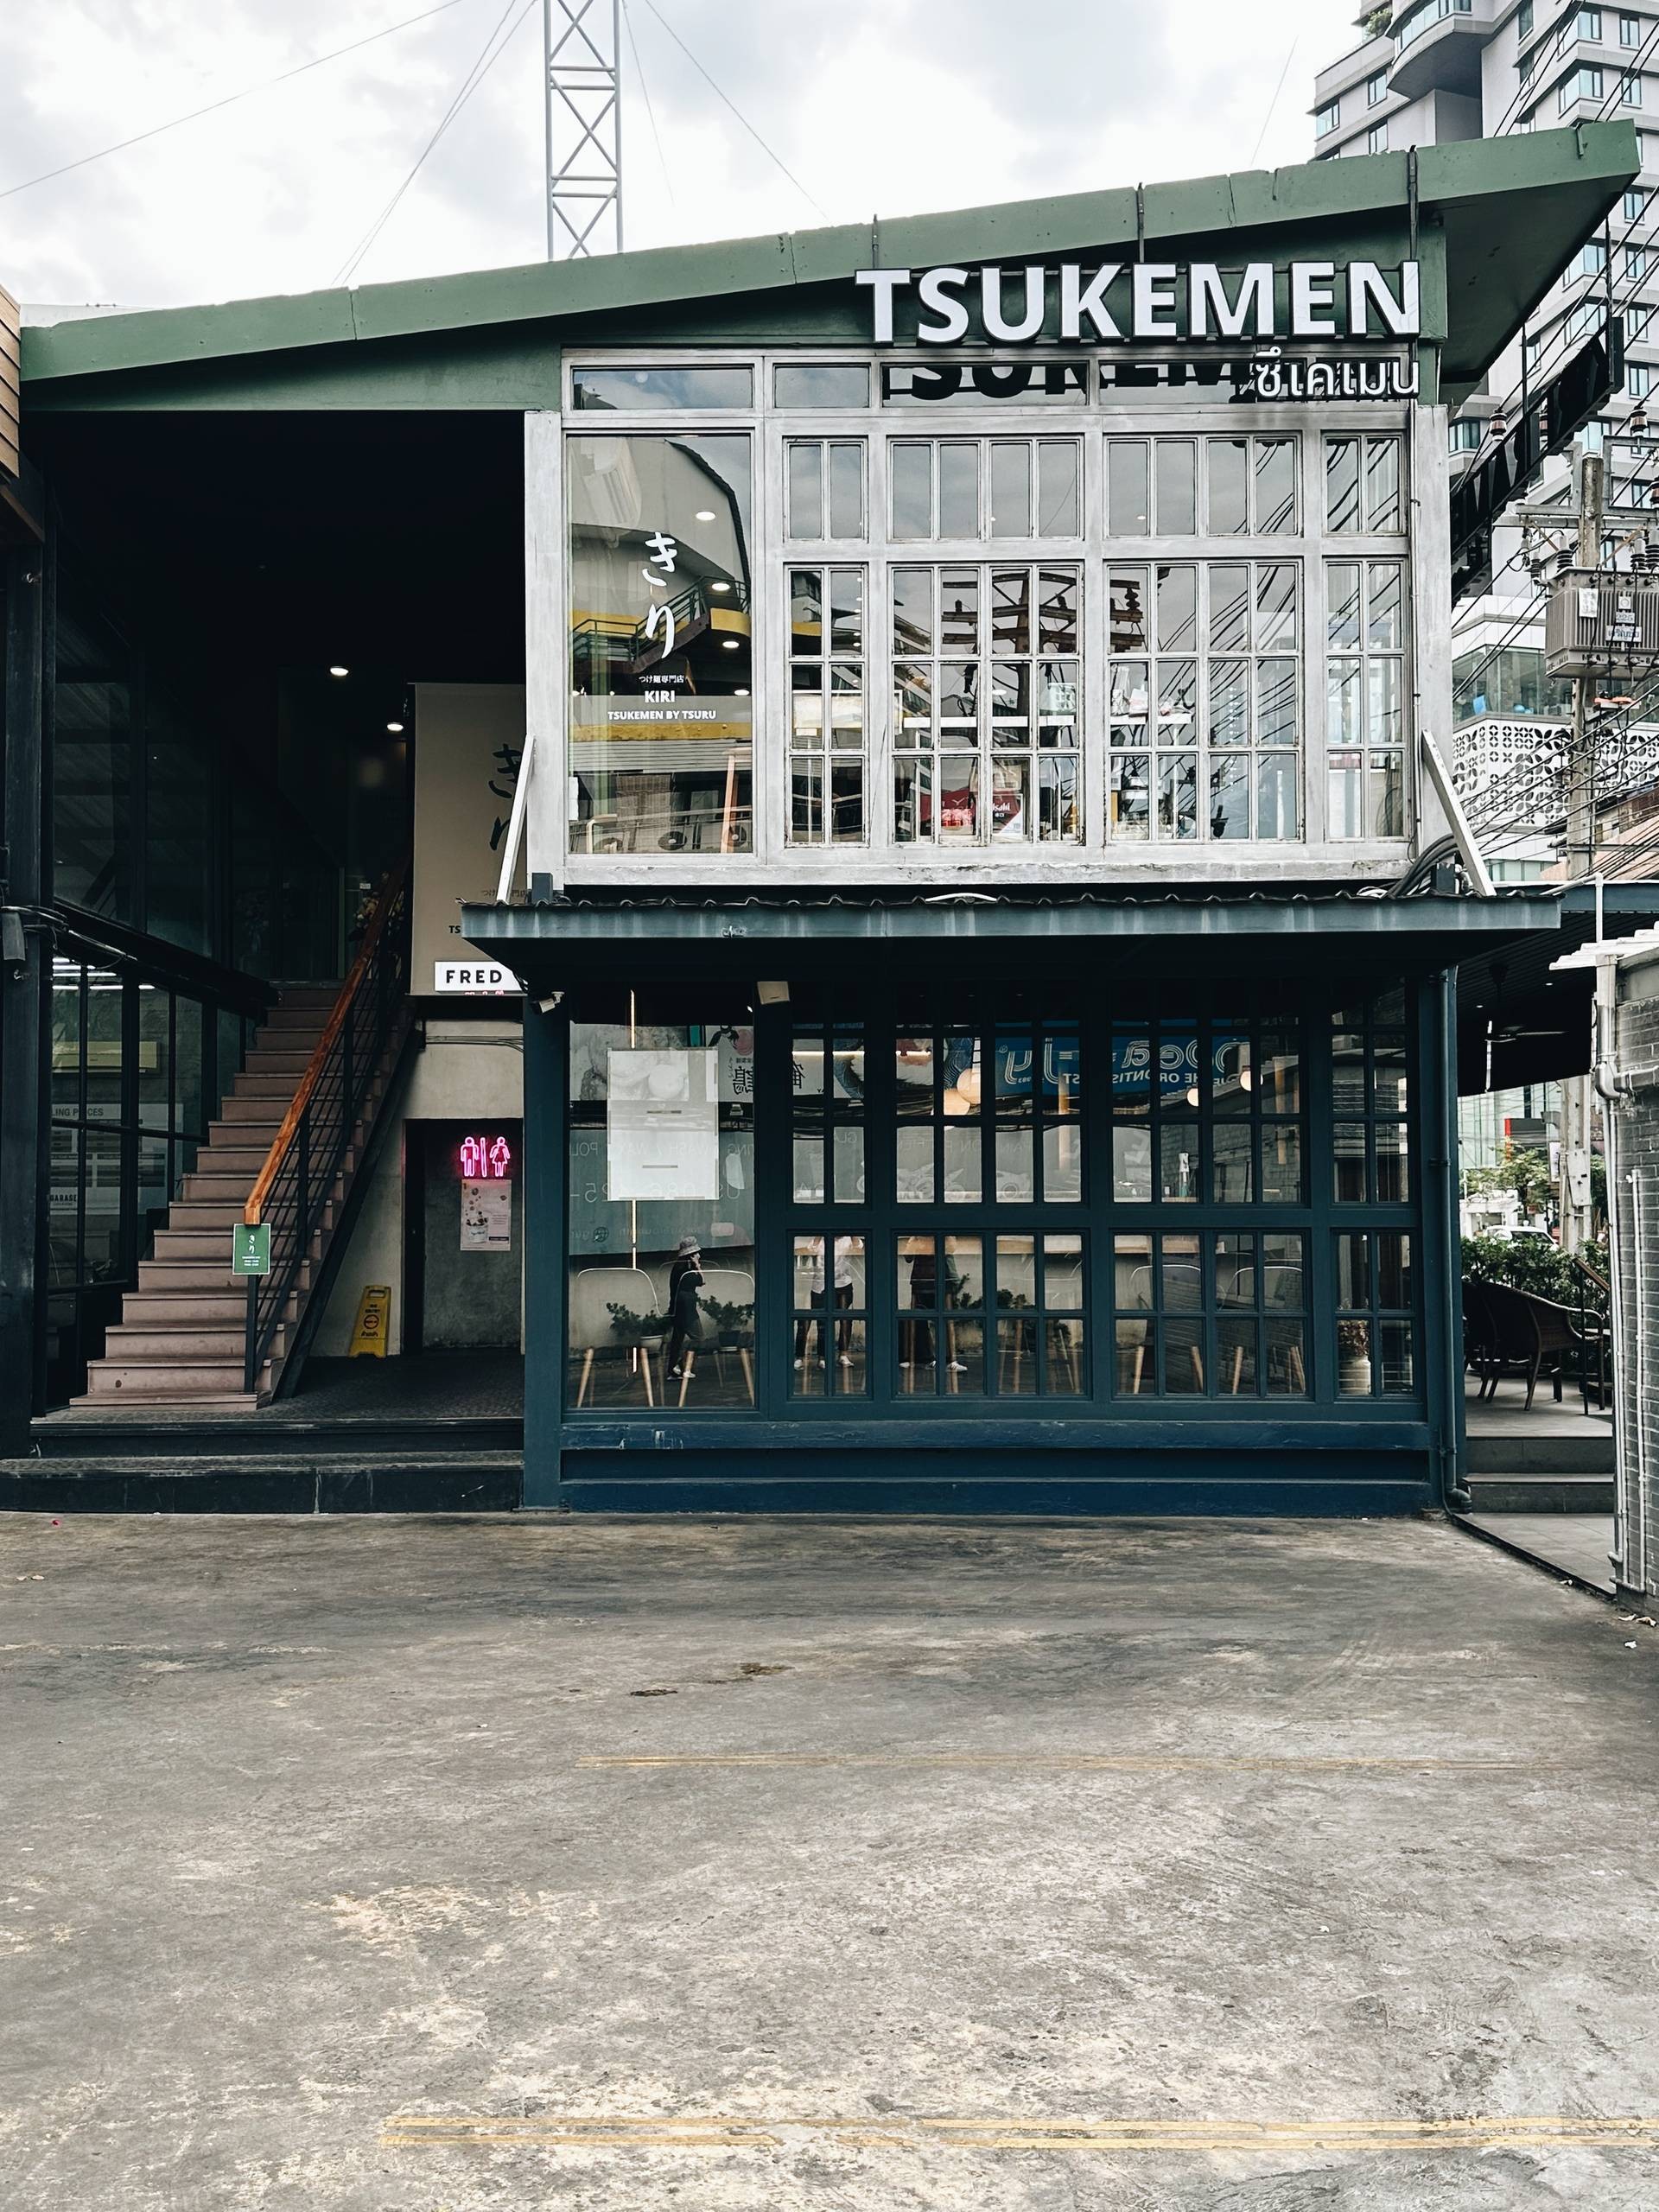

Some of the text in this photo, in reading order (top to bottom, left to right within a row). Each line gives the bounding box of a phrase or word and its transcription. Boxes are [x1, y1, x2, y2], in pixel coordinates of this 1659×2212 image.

[855, 261, 1421, 344] TSUKEMEN
[642, 532, 677, 658] きり
[645, 690, 676, 703] KIRI
[607, 710, 716, 721] TSUKEMEN BY TSURU
[446, 969, 503, 983] FRED
